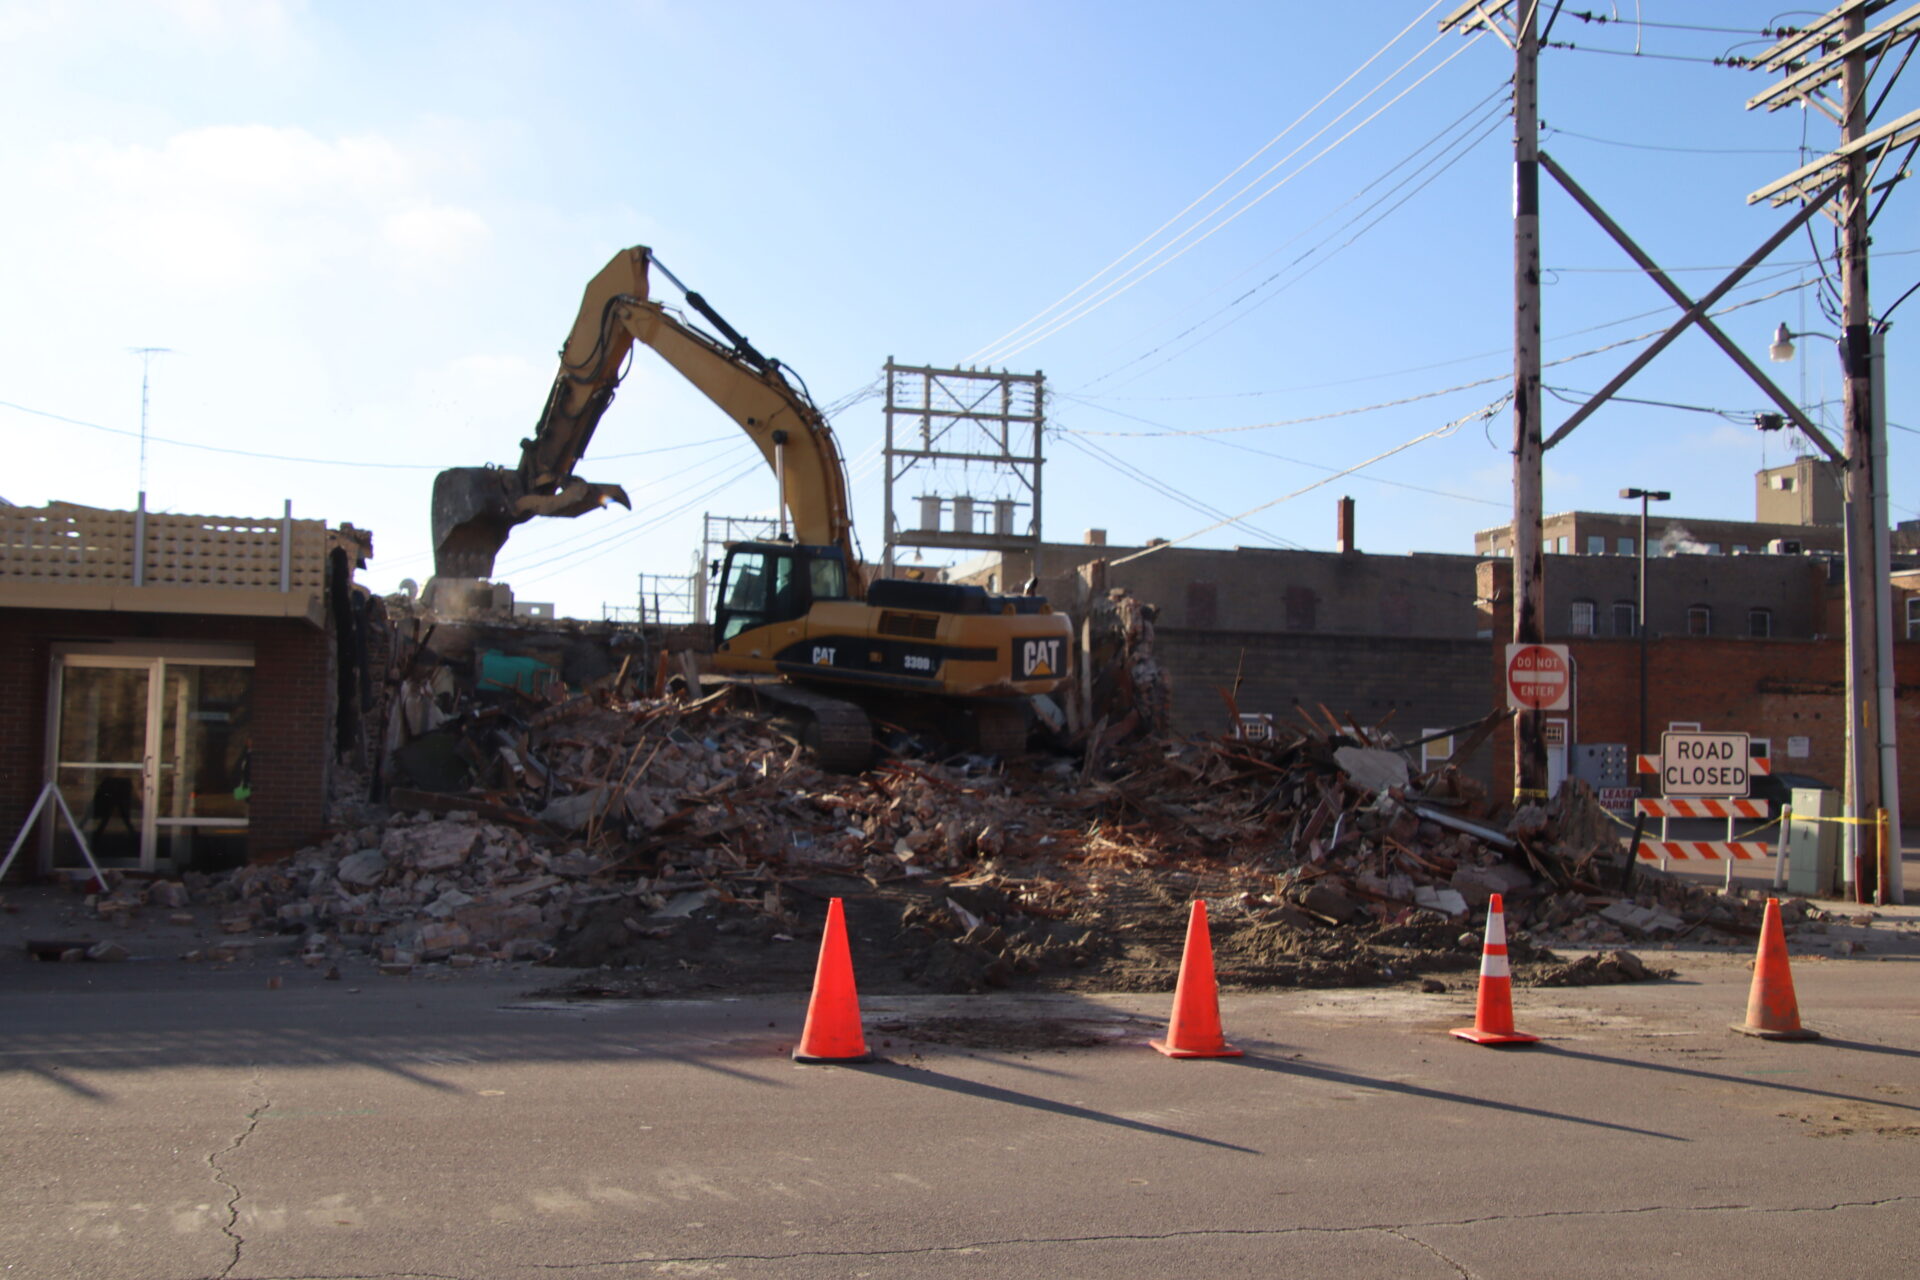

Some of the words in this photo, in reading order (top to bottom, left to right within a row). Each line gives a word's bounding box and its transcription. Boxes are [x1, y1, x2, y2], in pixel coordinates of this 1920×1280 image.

[812, 646, 836, 665] CAT
[1023, 641, 1060, 676] CAT
[1517, 657, 1532, 668] DO
[1537, 657, 1559, 669] NOT
[1520, 685, 1555, 697] ENTER
[1678, 741, 1734, 760] ROAD
[1666, 766, 1745, 785] CLOSED
